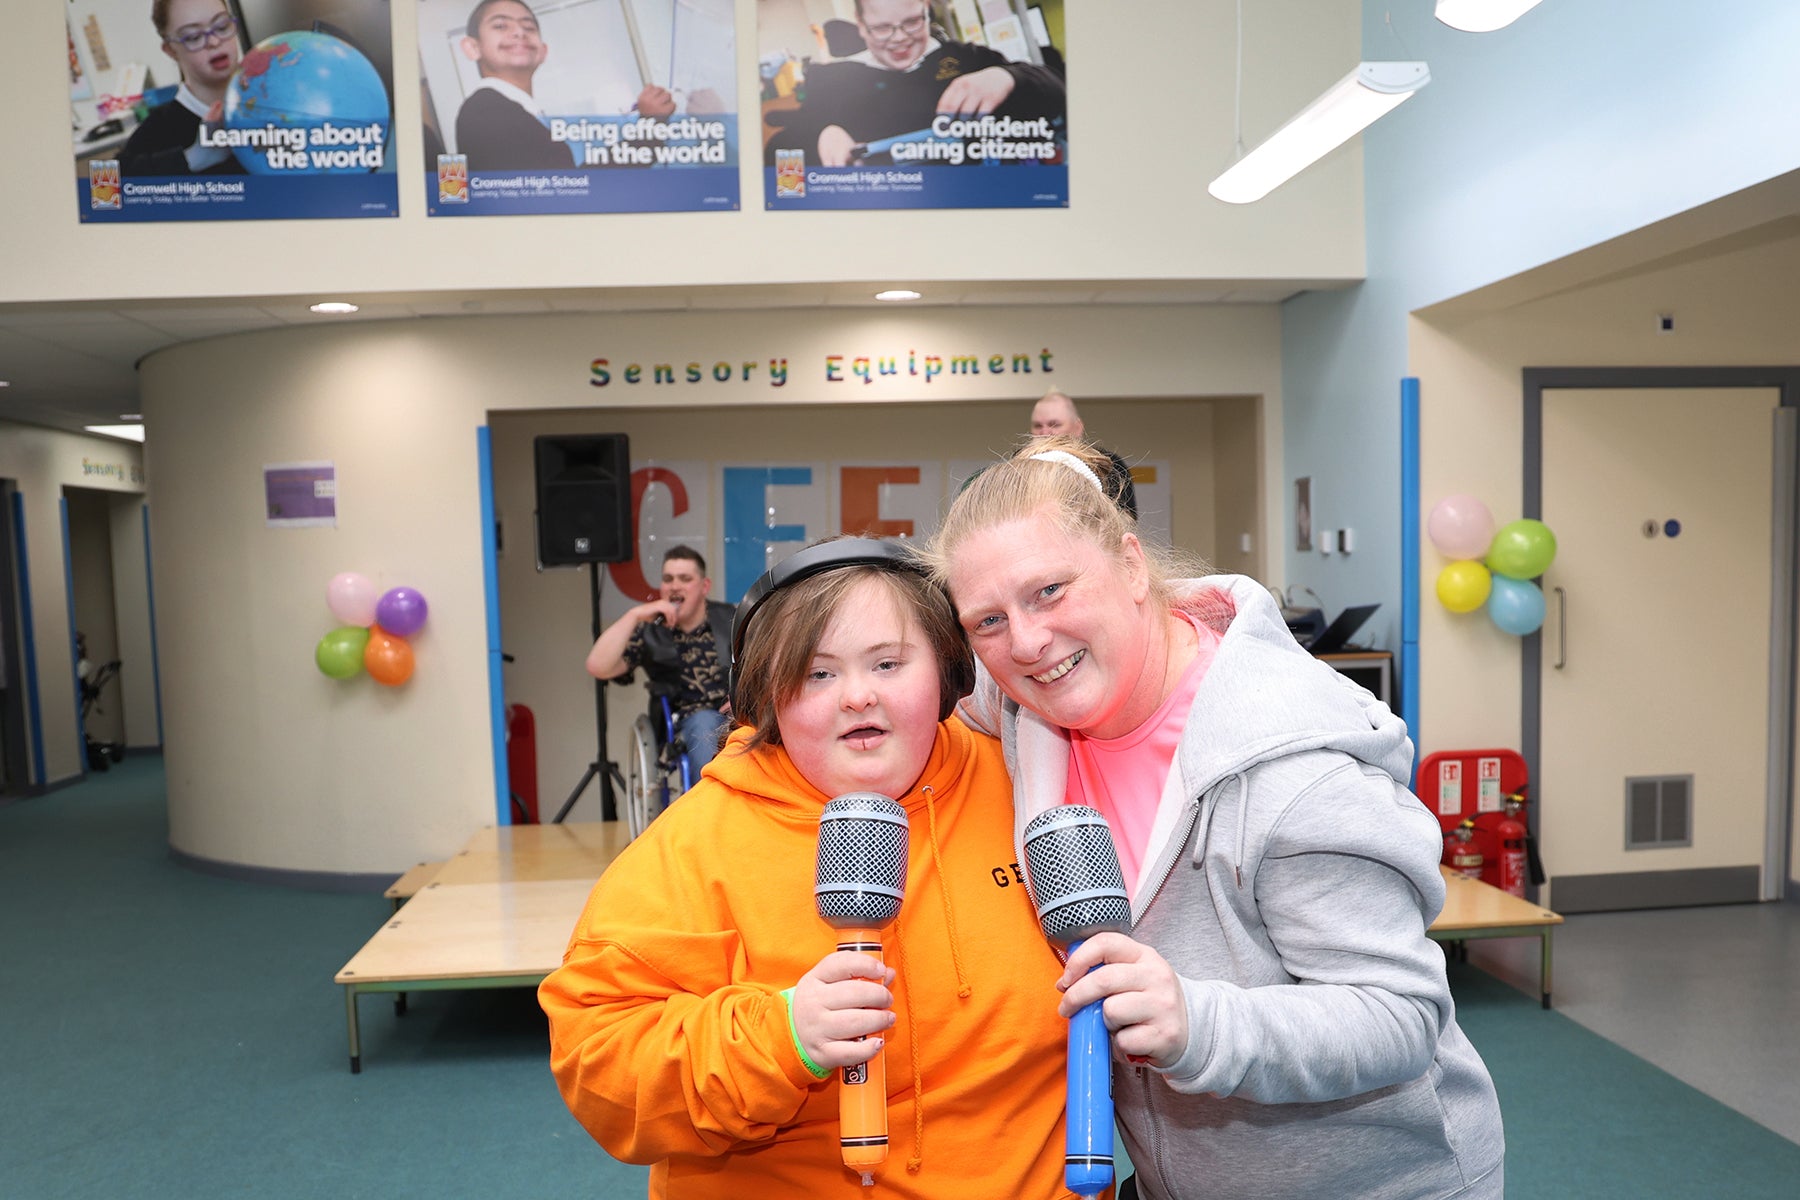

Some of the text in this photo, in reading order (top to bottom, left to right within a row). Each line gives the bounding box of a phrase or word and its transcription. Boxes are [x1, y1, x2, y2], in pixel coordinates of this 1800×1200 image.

[199, 122, 382, 149] Learning about
[550, 116, 725, 145] Being effective
[932, 116, 1053, 140] Confident,
[267, 144, 383, 170] the world
[585, 140, 725, 165] in the world
[890, 137, 1055, 165] caring citizens
[123, 181, 244, 197] Cromwell High School
[471, 175, 589, 191] Cromwell High School
[808, 171, 923, 186] Cromwell High School
[590, 347, 1055, 387] Sensory Equipment
